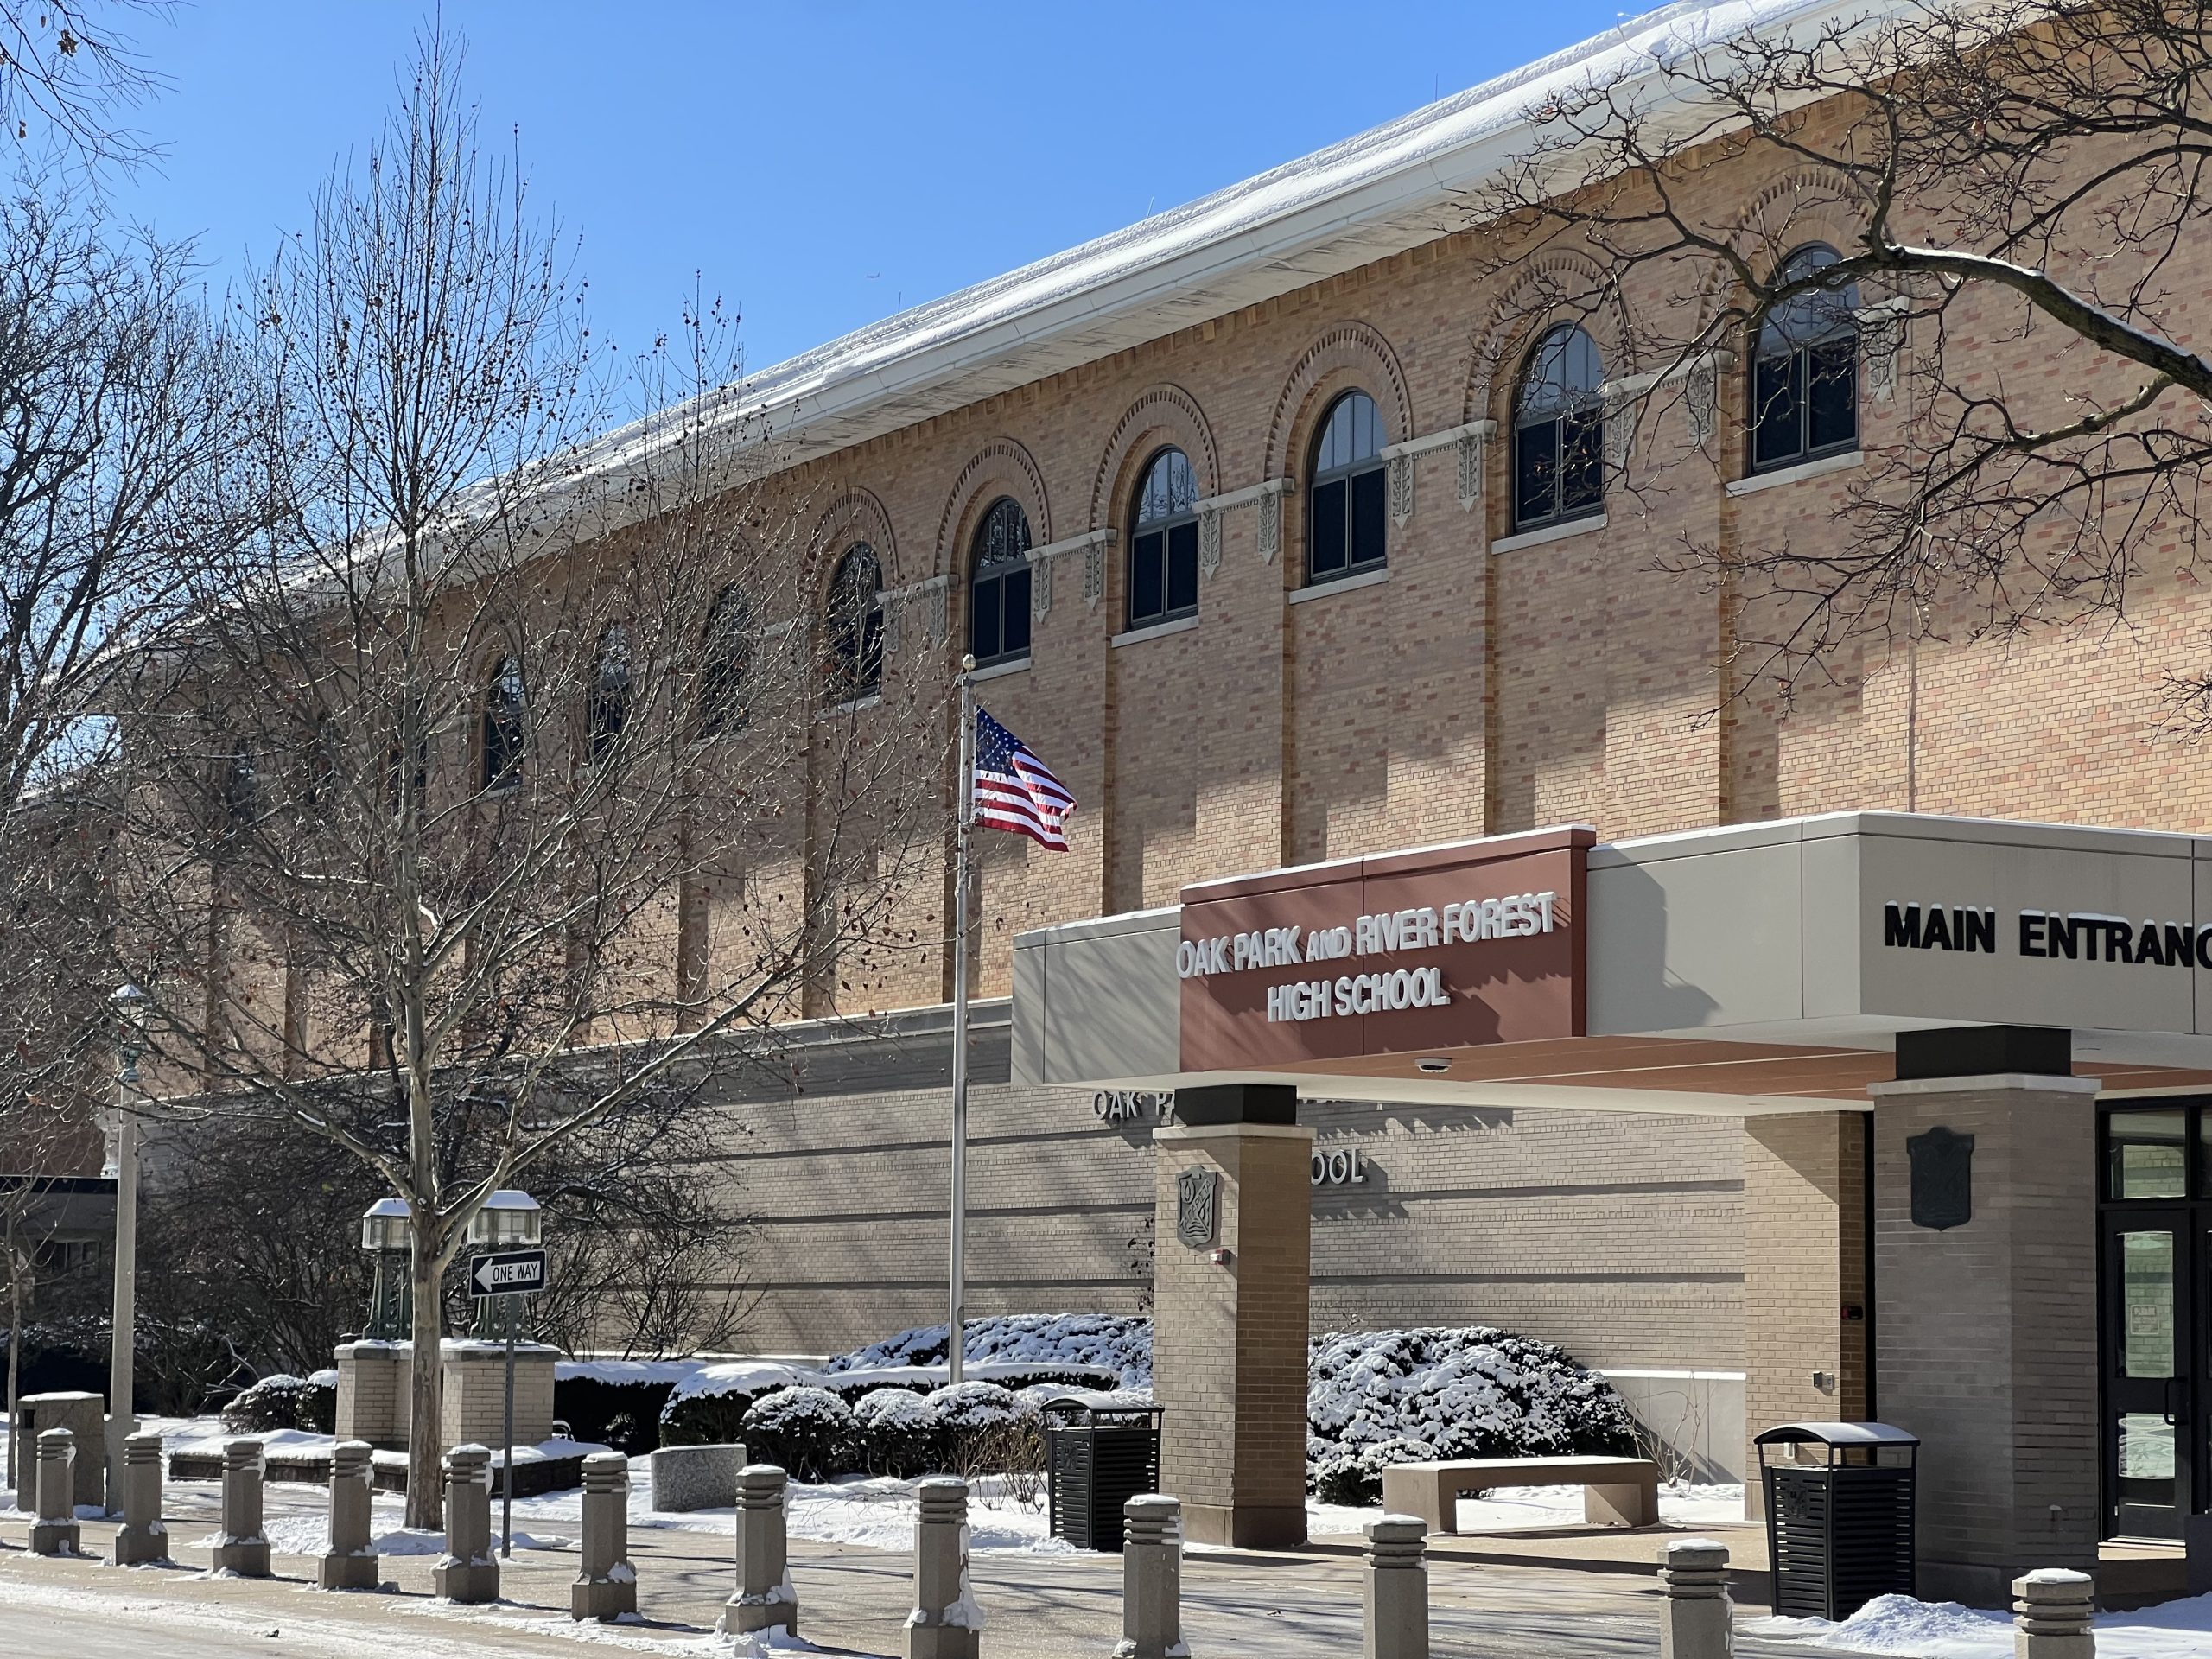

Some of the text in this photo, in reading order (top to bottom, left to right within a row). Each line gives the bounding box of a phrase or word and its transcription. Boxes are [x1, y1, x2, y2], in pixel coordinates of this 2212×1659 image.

[1176, 891, 1556, 979] OAK PARK AND RIVER FOREST
[1885, 900, 1995, 954] MAIN
[1268, 967, 1450, 1023] HIGH SCHOOL
[1092, 1090, 1138, 1120] OAK
[493, 1262, 538, 1281] ONE WAY
